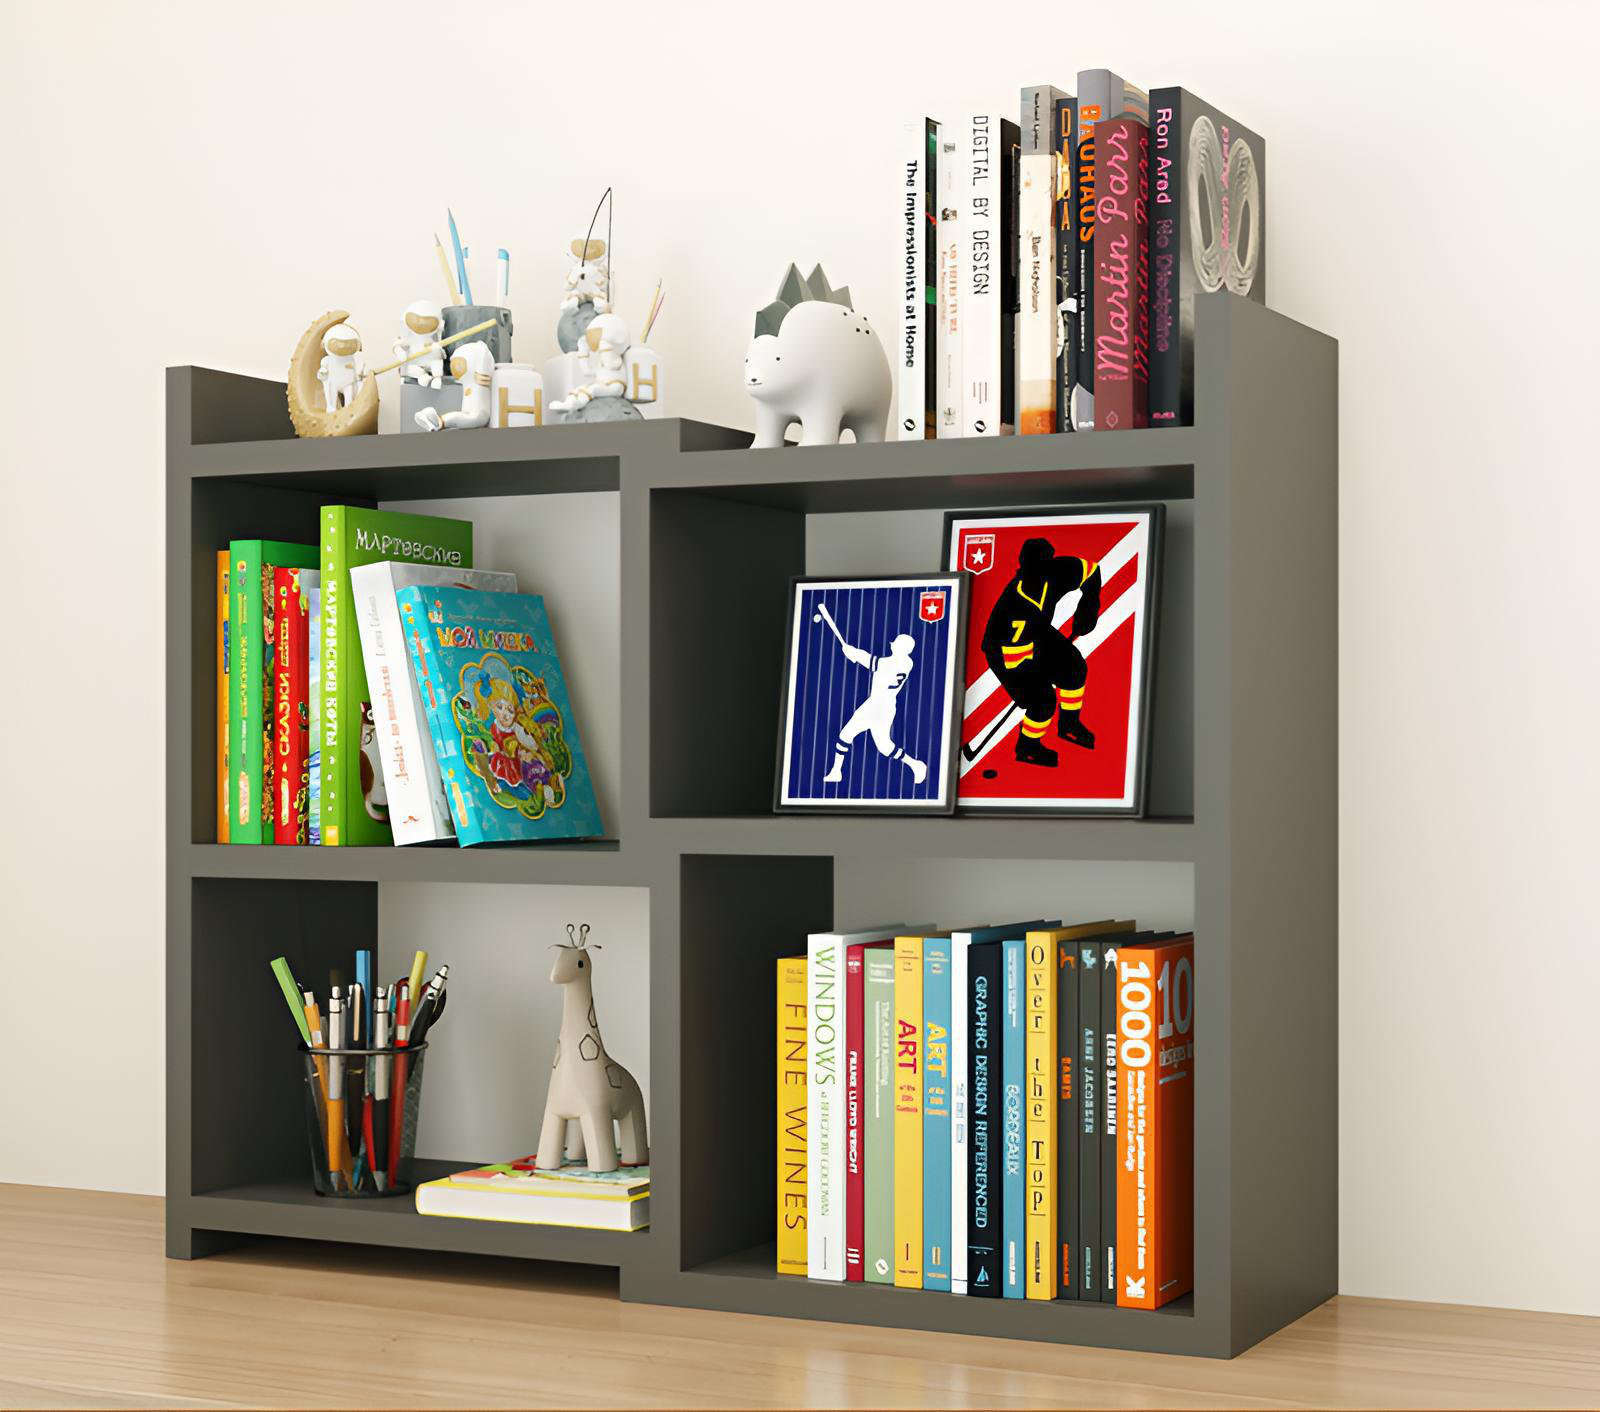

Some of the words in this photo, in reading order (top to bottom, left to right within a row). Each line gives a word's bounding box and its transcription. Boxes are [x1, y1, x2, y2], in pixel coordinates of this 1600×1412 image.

[972, 115, 989, 187] DIGITAL
[1157, 107, 1172, 149] Ron
[906, 160, 918, 187] The
[1079, 104, 1100, 242] BAUHAUS
[1097, 124, 1129, 224] Parr
[1156, 156, 1172, 204] Arad
[972, 197, 989, 217] BY
[905, 192, 918, 301] Impressionists
[972, 230, 989, 295] DESIGN
[906, 305, 917, 320] at
[1097, 233, 1129, 377] Martin
[905, 325, 916, 368] Home
[1011, 620, 1026, 643] 7
[785, 1003, 807, 1086] FINE
[815, 946, 836, 1086] WINDOWS
[974, 975, 988, 1049] GRAPHIC
[1120, 961, 1152, 1068] 1000
[897, 1019, 917, 1075] ART
[926, 1021, 947, 1078] ART
[974, 1054, 988, 1116] DESIGN
[785, 1105, 807, 1231] WINES
